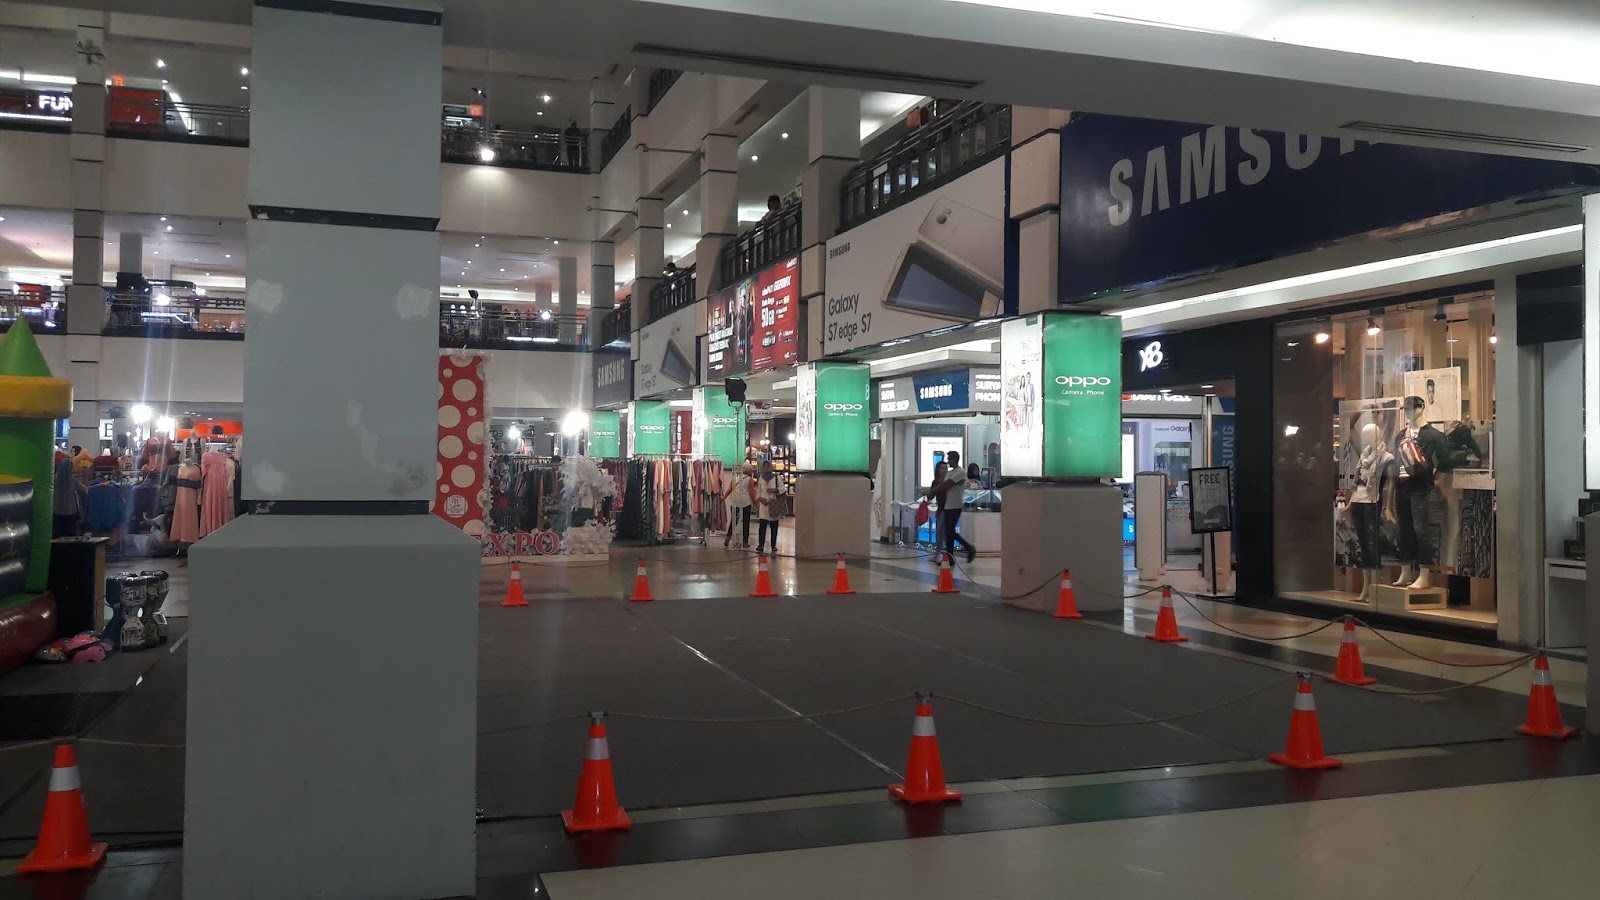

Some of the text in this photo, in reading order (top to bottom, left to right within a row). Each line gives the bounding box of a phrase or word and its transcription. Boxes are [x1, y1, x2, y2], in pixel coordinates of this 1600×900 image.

[1108, 125, 1383, 227] SAMSU
[829, 243, 851, 259] SAMSUNG
[828, 292, 859, 317] Galaxy
[828, 313, 872, 342] S7 edge S7
[598, 357, 625, 388] SAMSUNG
[920, 384, 952, 400] SAMSUNG
[1170, 425, 1190, 433] Galaxy
[1199, 473, 1220, 485] FREE
[471, 531, 560, 556] XPO
